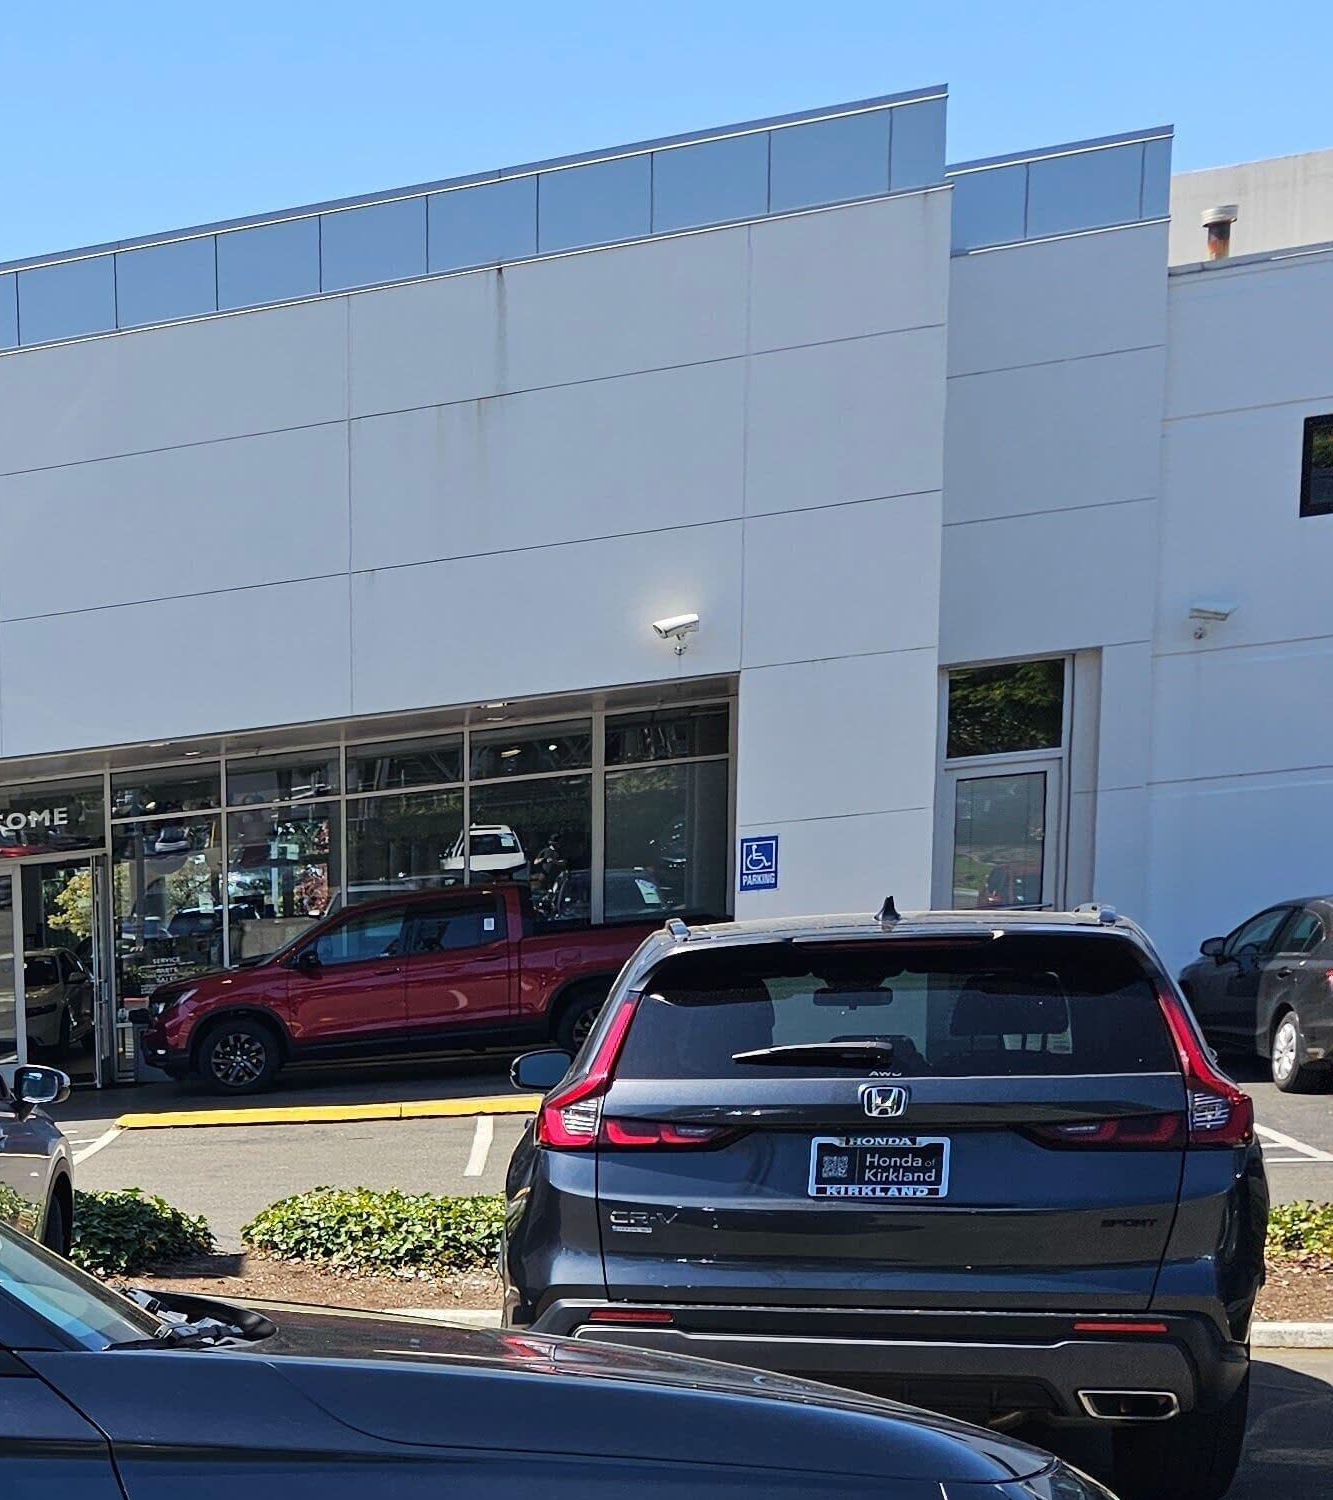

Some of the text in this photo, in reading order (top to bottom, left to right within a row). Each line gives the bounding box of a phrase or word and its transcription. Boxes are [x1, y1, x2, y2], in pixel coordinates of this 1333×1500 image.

[742, 873, 776, 886] PARKING
[152, 956, 180, 964] SERVICE
[848, 1137, 913, 1146] HONDA
[866, 1153, 923, 1167] Honda
[864, 1168, 936, 1182] Kirkland
[826, 1186, 930, 1196] KIRKLAND
[609, 1210, 679, 1225] CR-V
